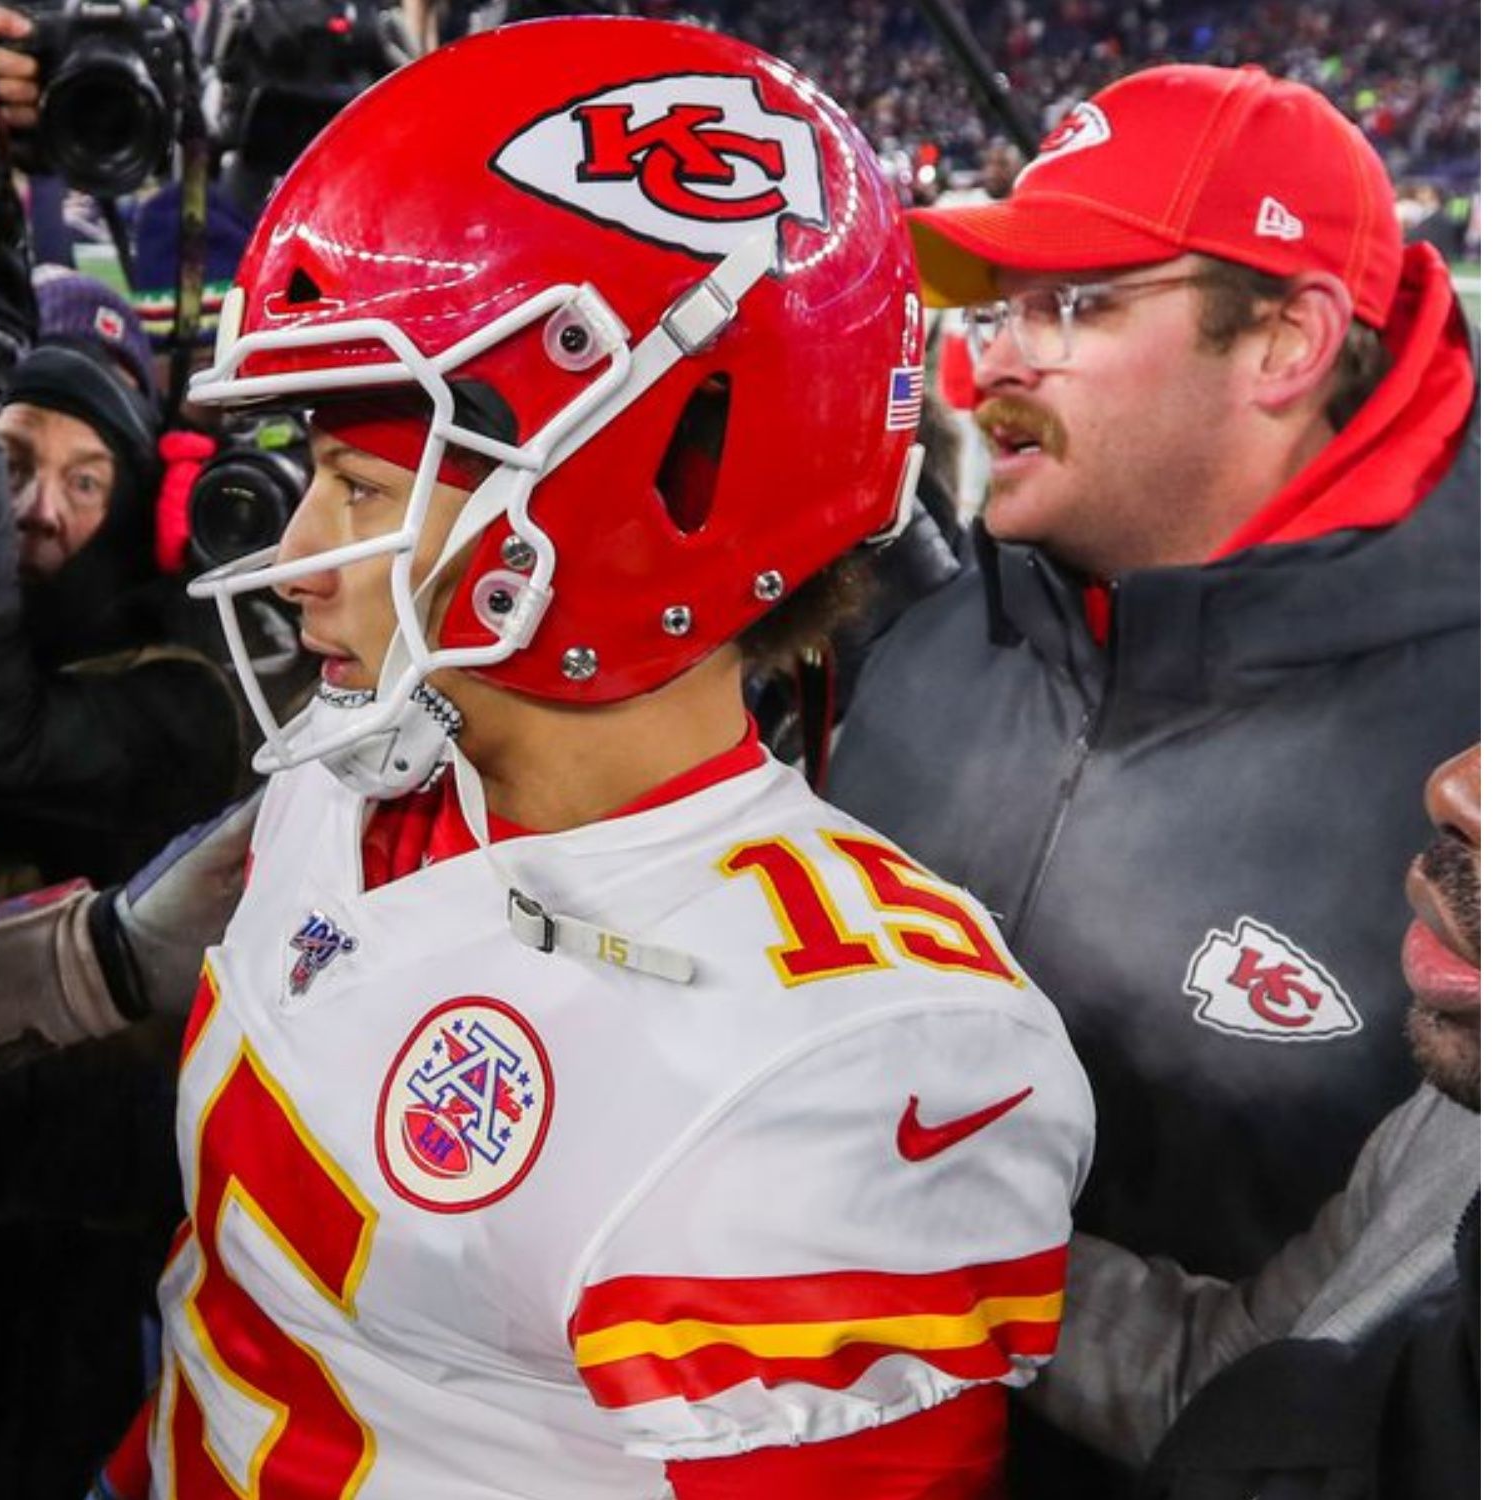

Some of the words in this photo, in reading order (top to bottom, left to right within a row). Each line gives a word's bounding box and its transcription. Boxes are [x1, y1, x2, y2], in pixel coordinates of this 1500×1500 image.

[573, 103, 788, 222] KC
[597, 931, 631, 968] 15
[712, 828, 1027, 990] 15
[1227, 945, 1322, 1028] KC
